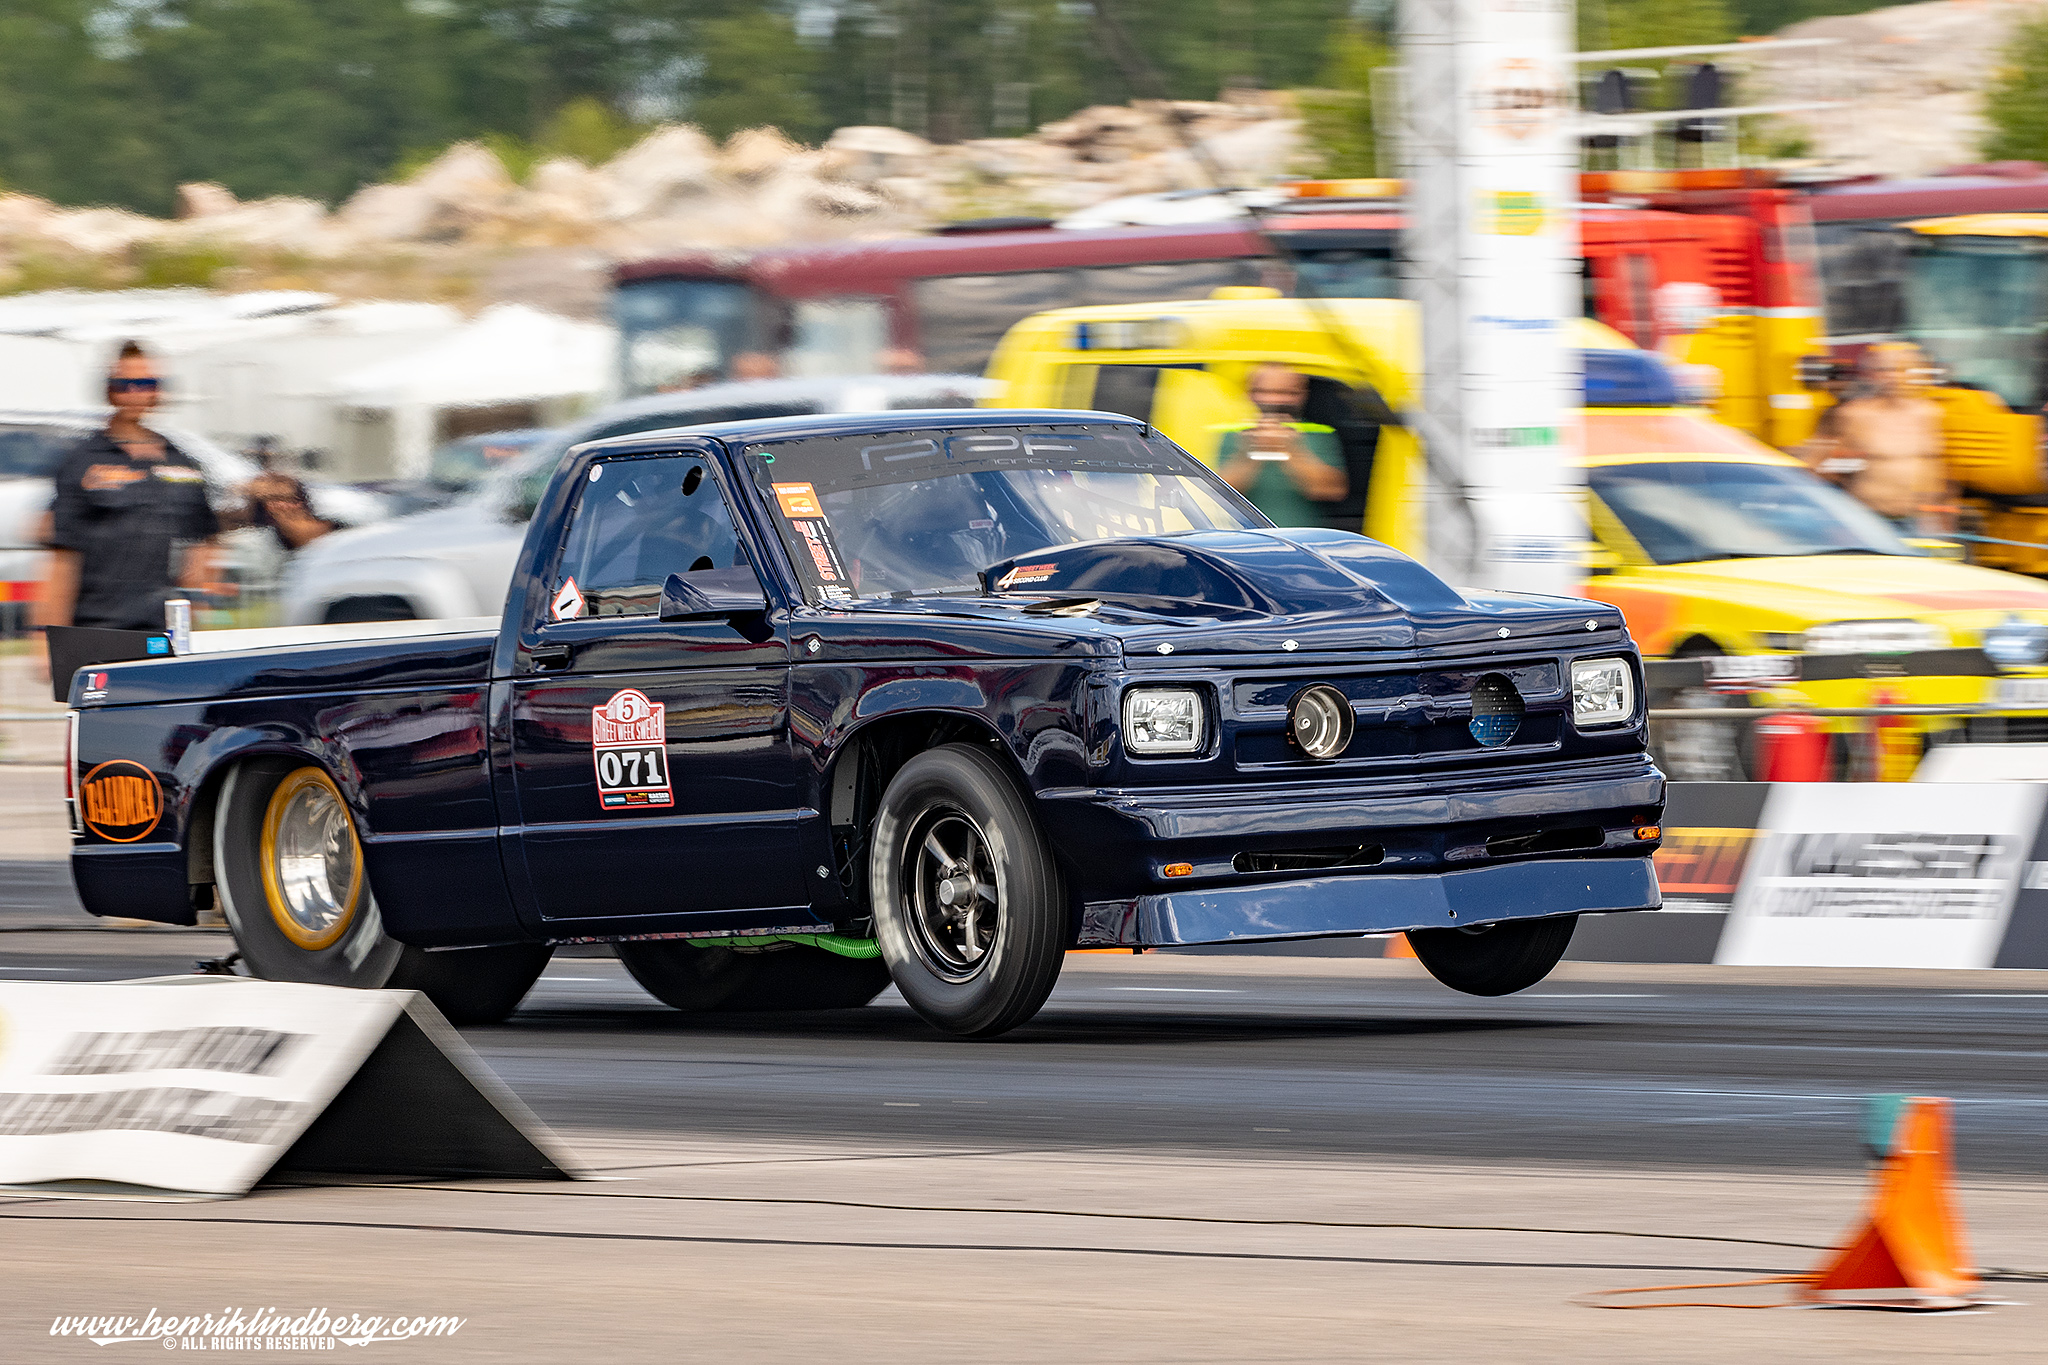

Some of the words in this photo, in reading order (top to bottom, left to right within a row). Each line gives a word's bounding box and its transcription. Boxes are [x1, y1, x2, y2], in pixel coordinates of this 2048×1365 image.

[860, 434, 1095, 471] PPF
[804, 536, 837, 581] STREET
[997, 567, 1019, 589] 4
[622, 697, 634, 720] 5
[600, 751, 663, 787] 071
